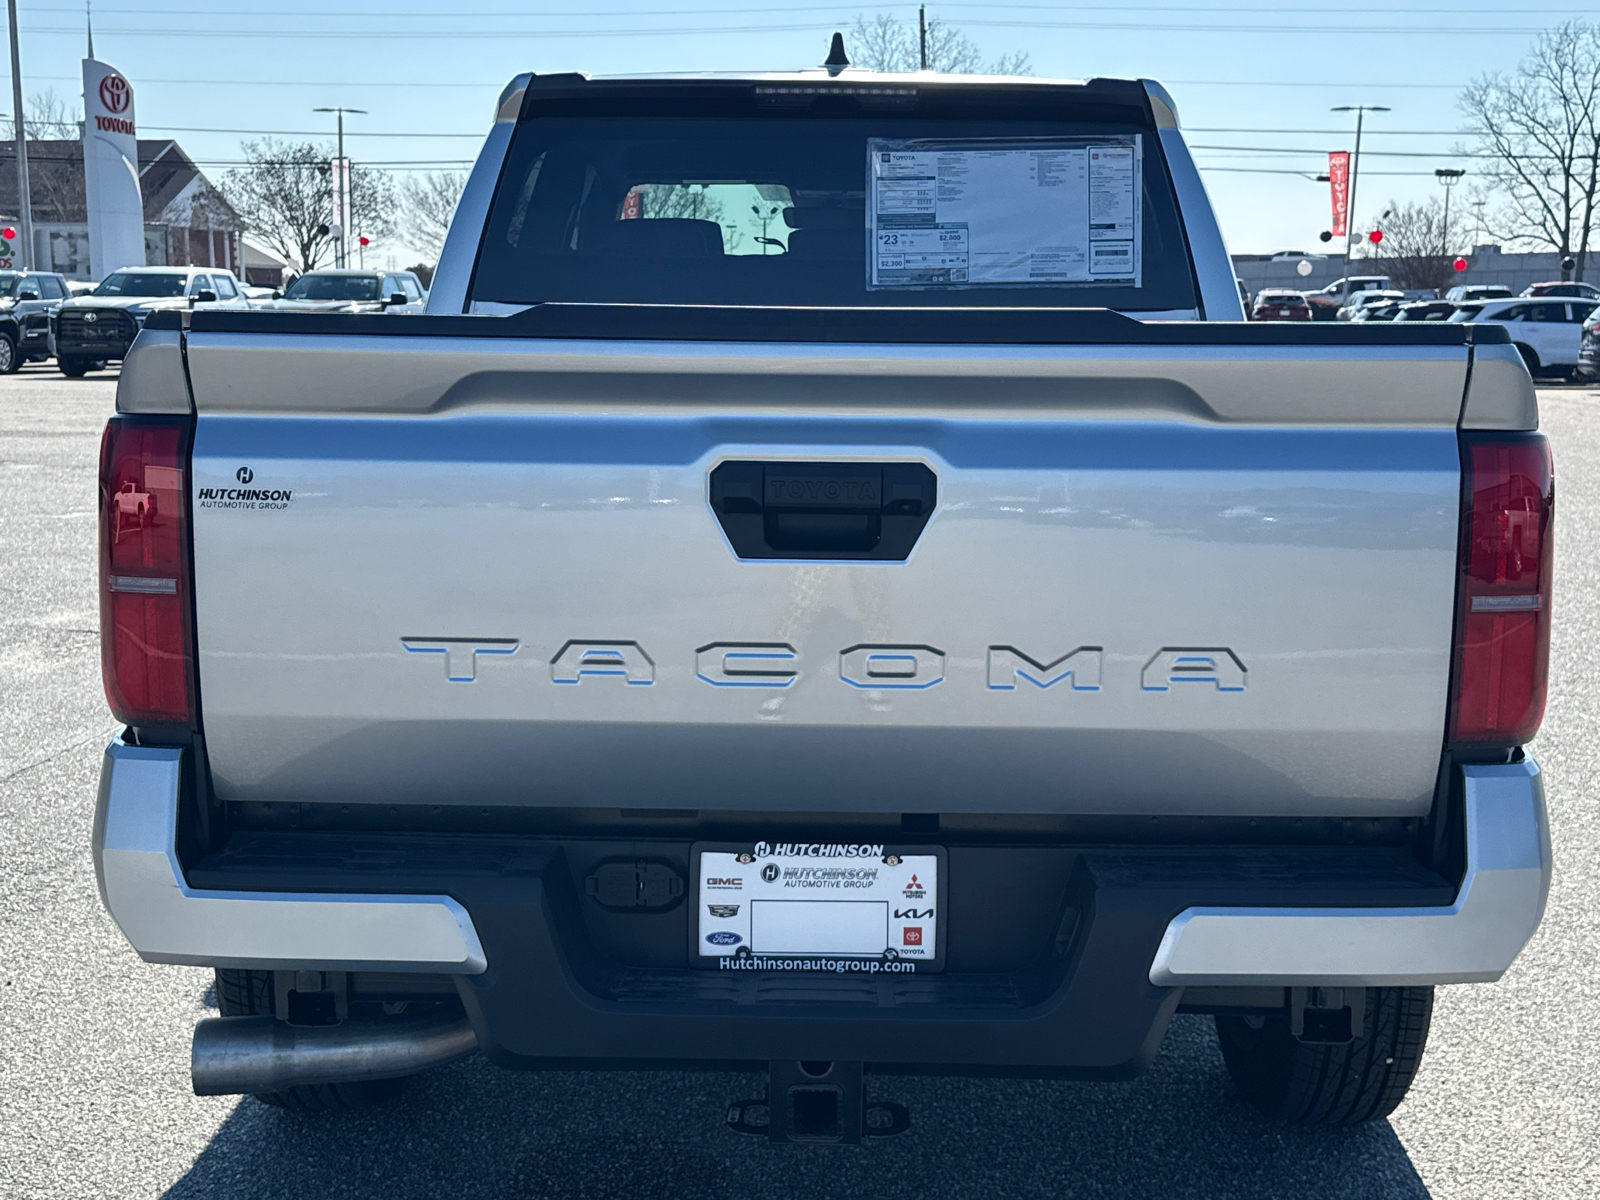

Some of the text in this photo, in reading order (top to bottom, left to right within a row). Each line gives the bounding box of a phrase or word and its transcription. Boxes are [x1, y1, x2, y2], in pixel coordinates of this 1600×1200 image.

[95, 115, 135, 135] TOYOTA
[883, 234, 899, 245] 23
[198, 488, 292, 501] HUTCHINSON
[770, 480, 876, 499] TOYOTA
[200, 501, 288, 510] AUTOMOTIVE GROUP
[400, 636, 1248, 692] TACOMA
[773, 843, 885, 858] HUTCHINSON
[782, 867, 879, 880] HUTCHINSON
[784, 880, 874, 888] AUTOMOTIVE GROUP
[894, 908, 934, 919] KIA
[712, 933, 736, 944] Ford
[719, 956, 916, 974] Hutchinsonautogroup.com
